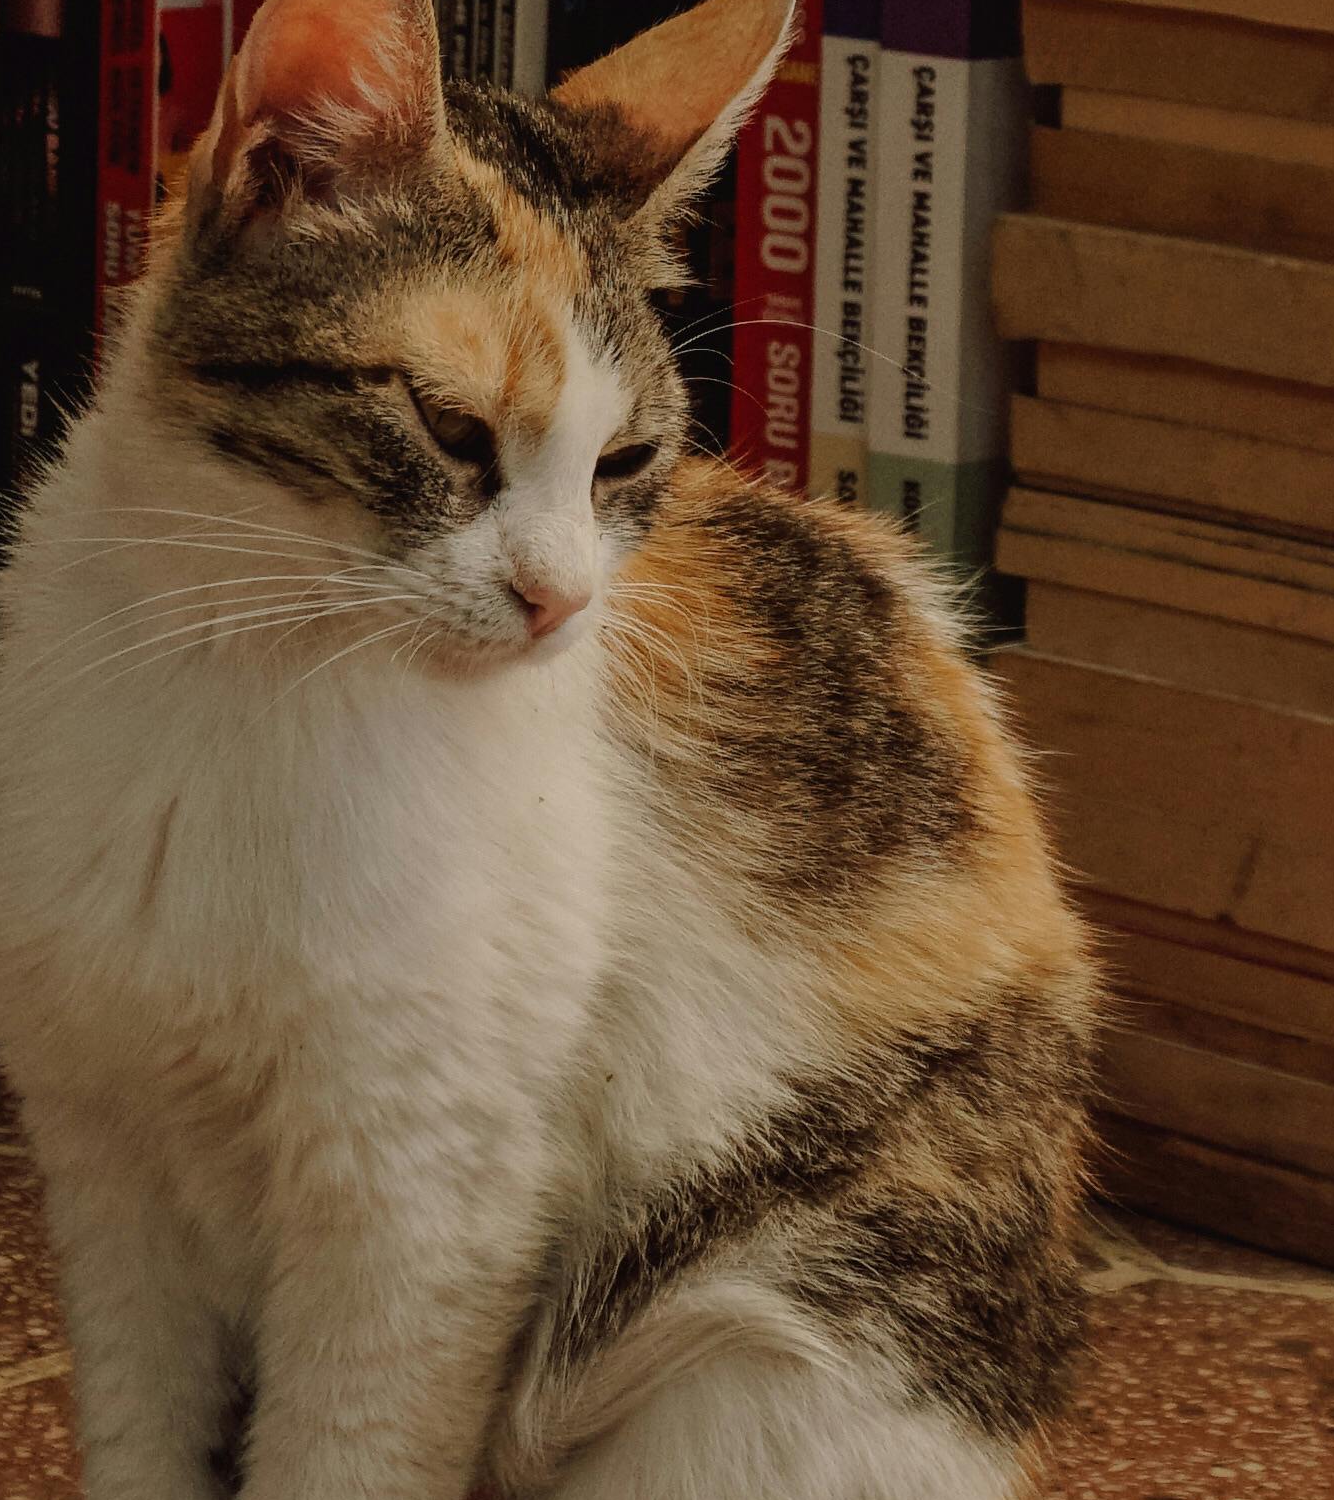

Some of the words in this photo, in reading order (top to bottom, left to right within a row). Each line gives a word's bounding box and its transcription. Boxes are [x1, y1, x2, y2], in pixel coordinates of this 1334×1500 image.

[844, 54, 870, 131] ÇARŞI
[910, 66, 937, 142] ÇARŞI
[760, 113, 813, 275] 2000
[842, 140, 868, 170] VE
[909, 150, 934, 184] VE
[102, 200, 121, 279] SORU
[840, 178, 867, 295] MAHALLE
[909, 191, 931, 308] MAHALLE
[765, 340, 803, 450] SORU
[839, 303, 865, 424] BEKÇİLİĞİ
[904, 316, 929, 440] BEKÇİLİĞİ
